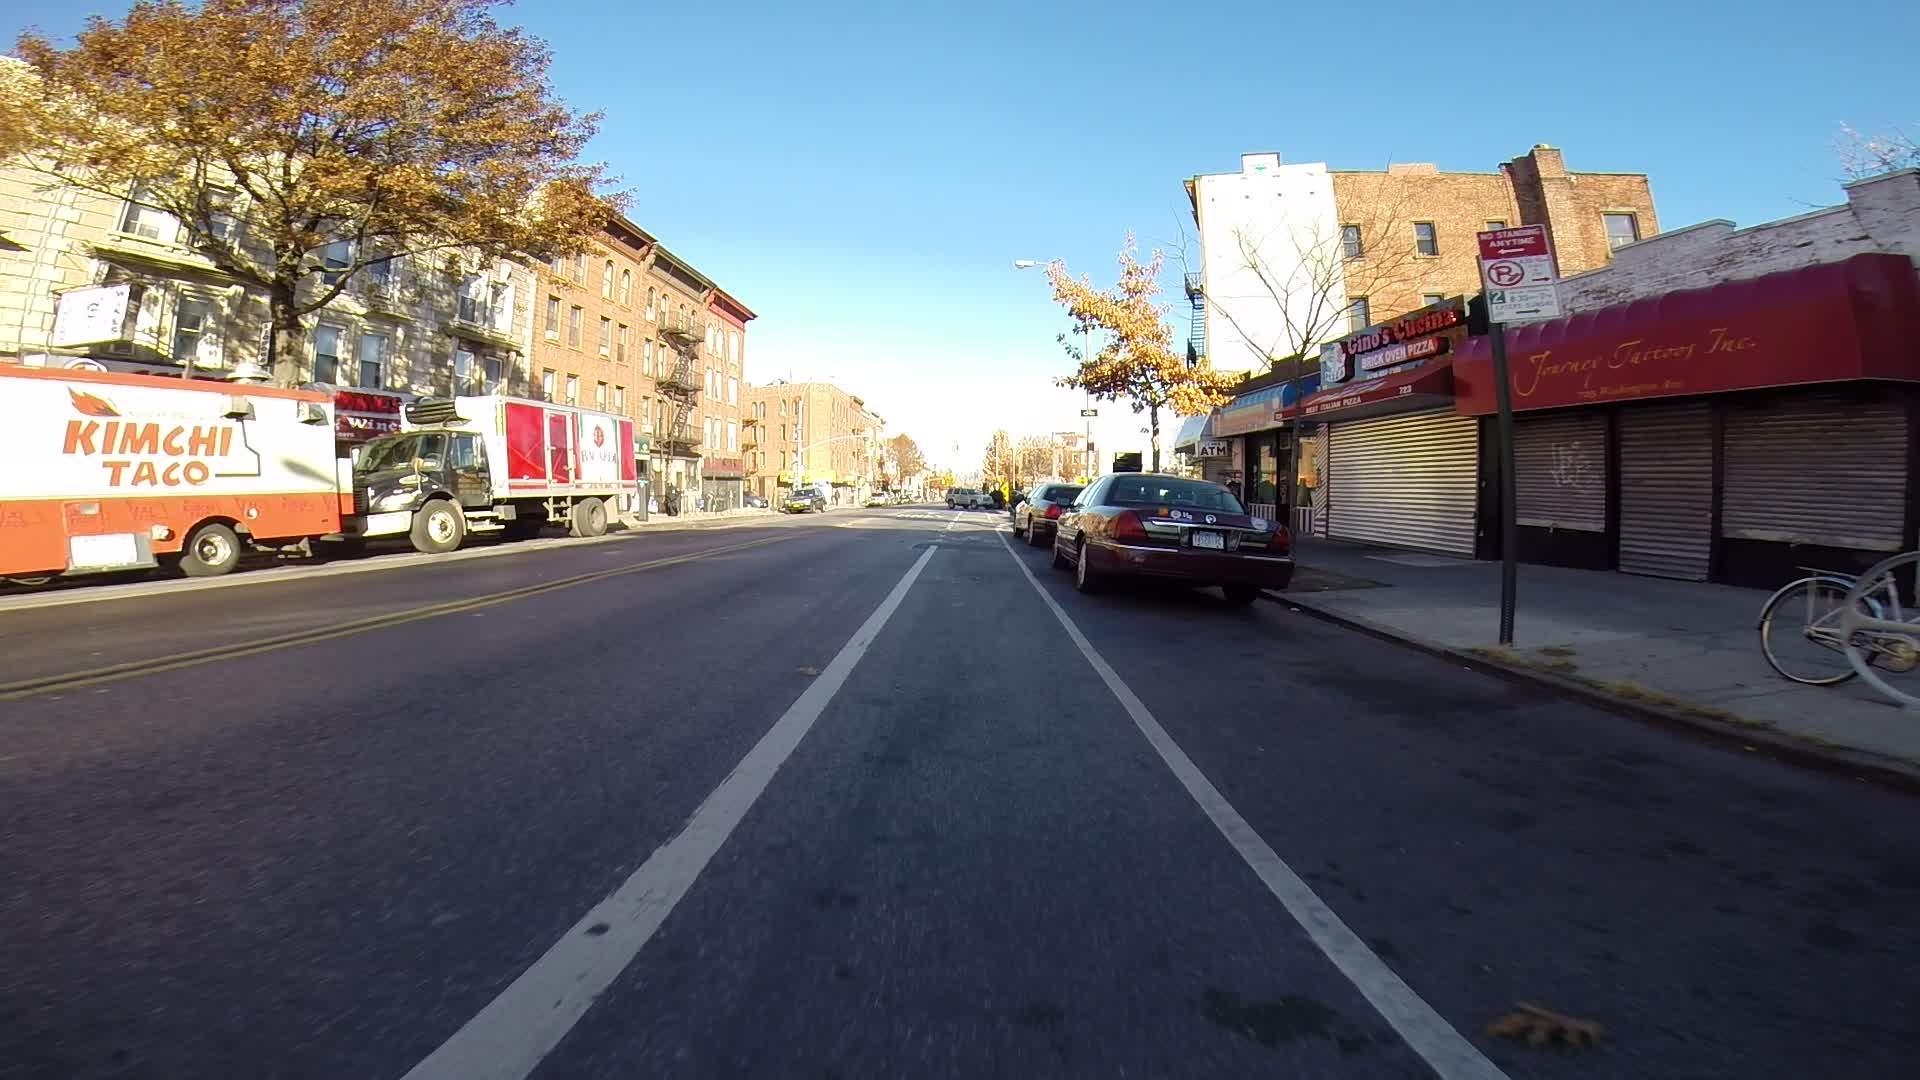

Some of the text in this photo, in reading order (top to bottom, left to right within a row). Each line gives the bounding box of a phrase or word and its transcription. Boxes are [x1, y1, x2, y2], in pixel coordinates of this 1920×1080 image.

[1489, 236, 1536, 248] ANYTIME
[1492, 291, 1503, 303] 2
[1347, 327, 1391, 355] Gino's
[1361, 338, 1436, 370] BRICK OVEN PIZZA
[1513, 350, 1603, 396] Journey
[1608, 339, 1697, 369] Tattoos
[1704, 327, 1757, 354] Inc.
[1320, 400, 1341, 411] ITALIAN
[1342, 396, 1362, 405] PIZZA
[63, 420, 233, 456] KIMCHI
[1200, 446, 1226, 456] ATM
[102, 460, 210, 487] TACO
